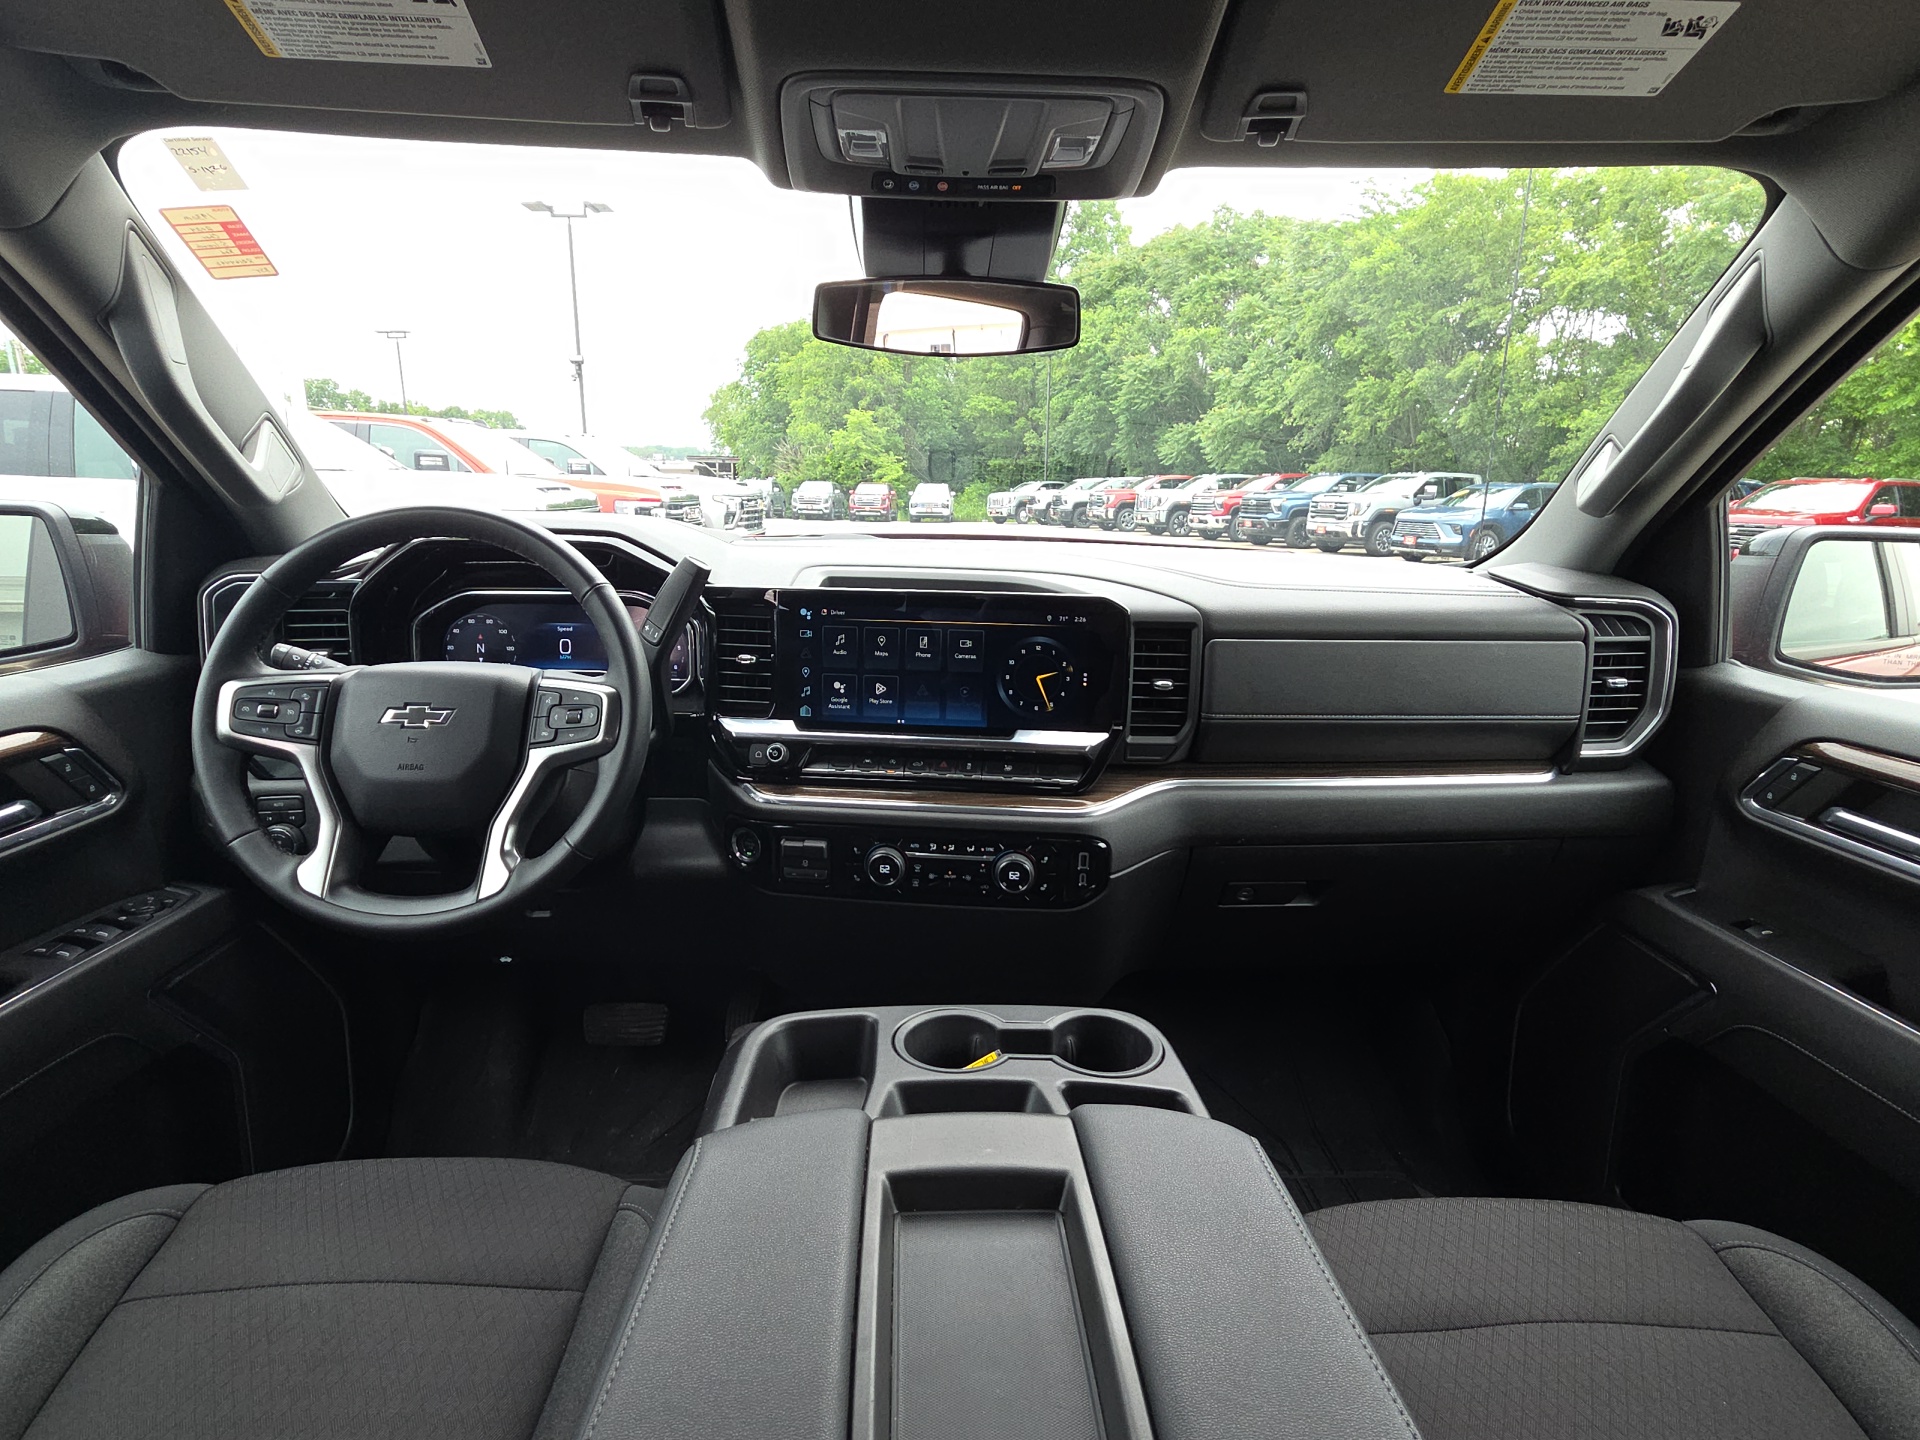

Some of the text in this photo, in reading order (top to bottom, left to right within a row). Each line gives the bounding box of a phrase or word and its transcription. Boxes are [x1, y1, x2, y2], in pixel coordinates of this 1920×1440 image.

[476, 643, 485, 653] N
[559, 638, 572, 655] 0
[830, 696, 848, 704] Google
[397, 763, 425, 771] AIRBAG
[879, 864, 891, 874] 62
[1008, 871, 1020, 880] 62
